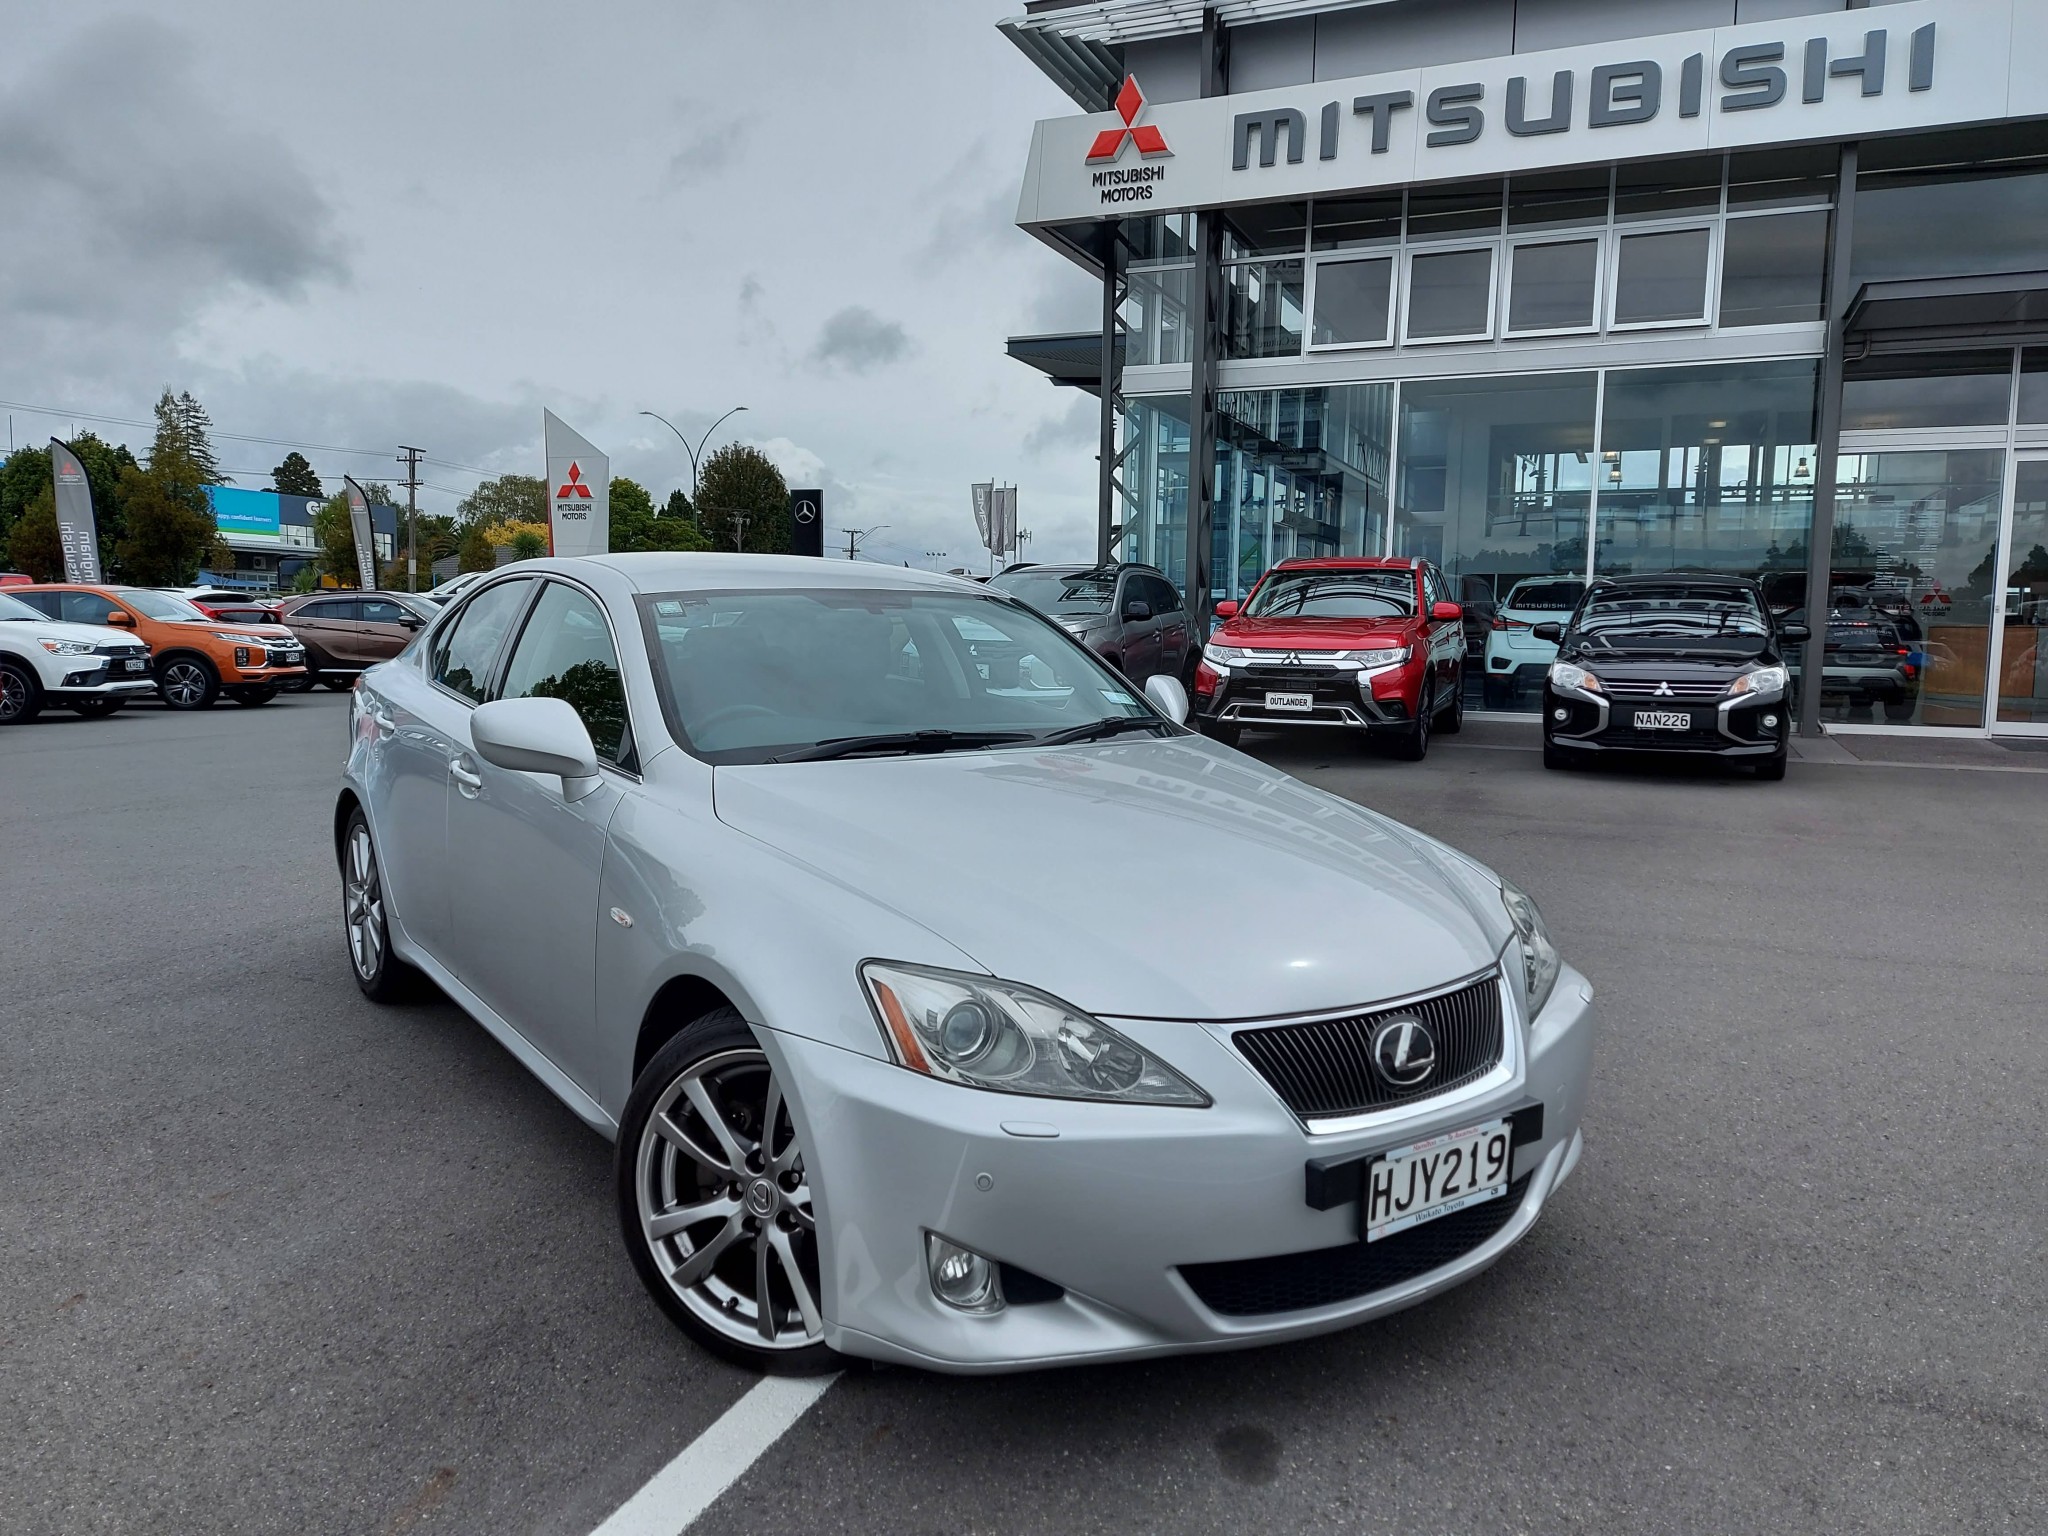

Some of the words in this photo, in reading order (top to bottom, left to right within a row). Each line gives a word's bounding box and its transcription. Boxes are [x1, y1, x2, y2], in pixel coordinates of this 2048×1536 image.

[1232, 21, 1936, 172] MITSUBISHI
[1092, 165, 1165, 187] MITSUBISHI
[1101, 185, 1153, 204] MOTORS
[557, 503, 592, 511] MITSUBISHI
[1269, 697, 1308, 707] OUTLANDER
[1636, 713, 1689, 727] NAN226
[1370, 1133, 1507, 1222] HJY219
[1415, 1208, 1442, 1223] Waikato
[1444, 1200, 1465, 1213] Toyota
